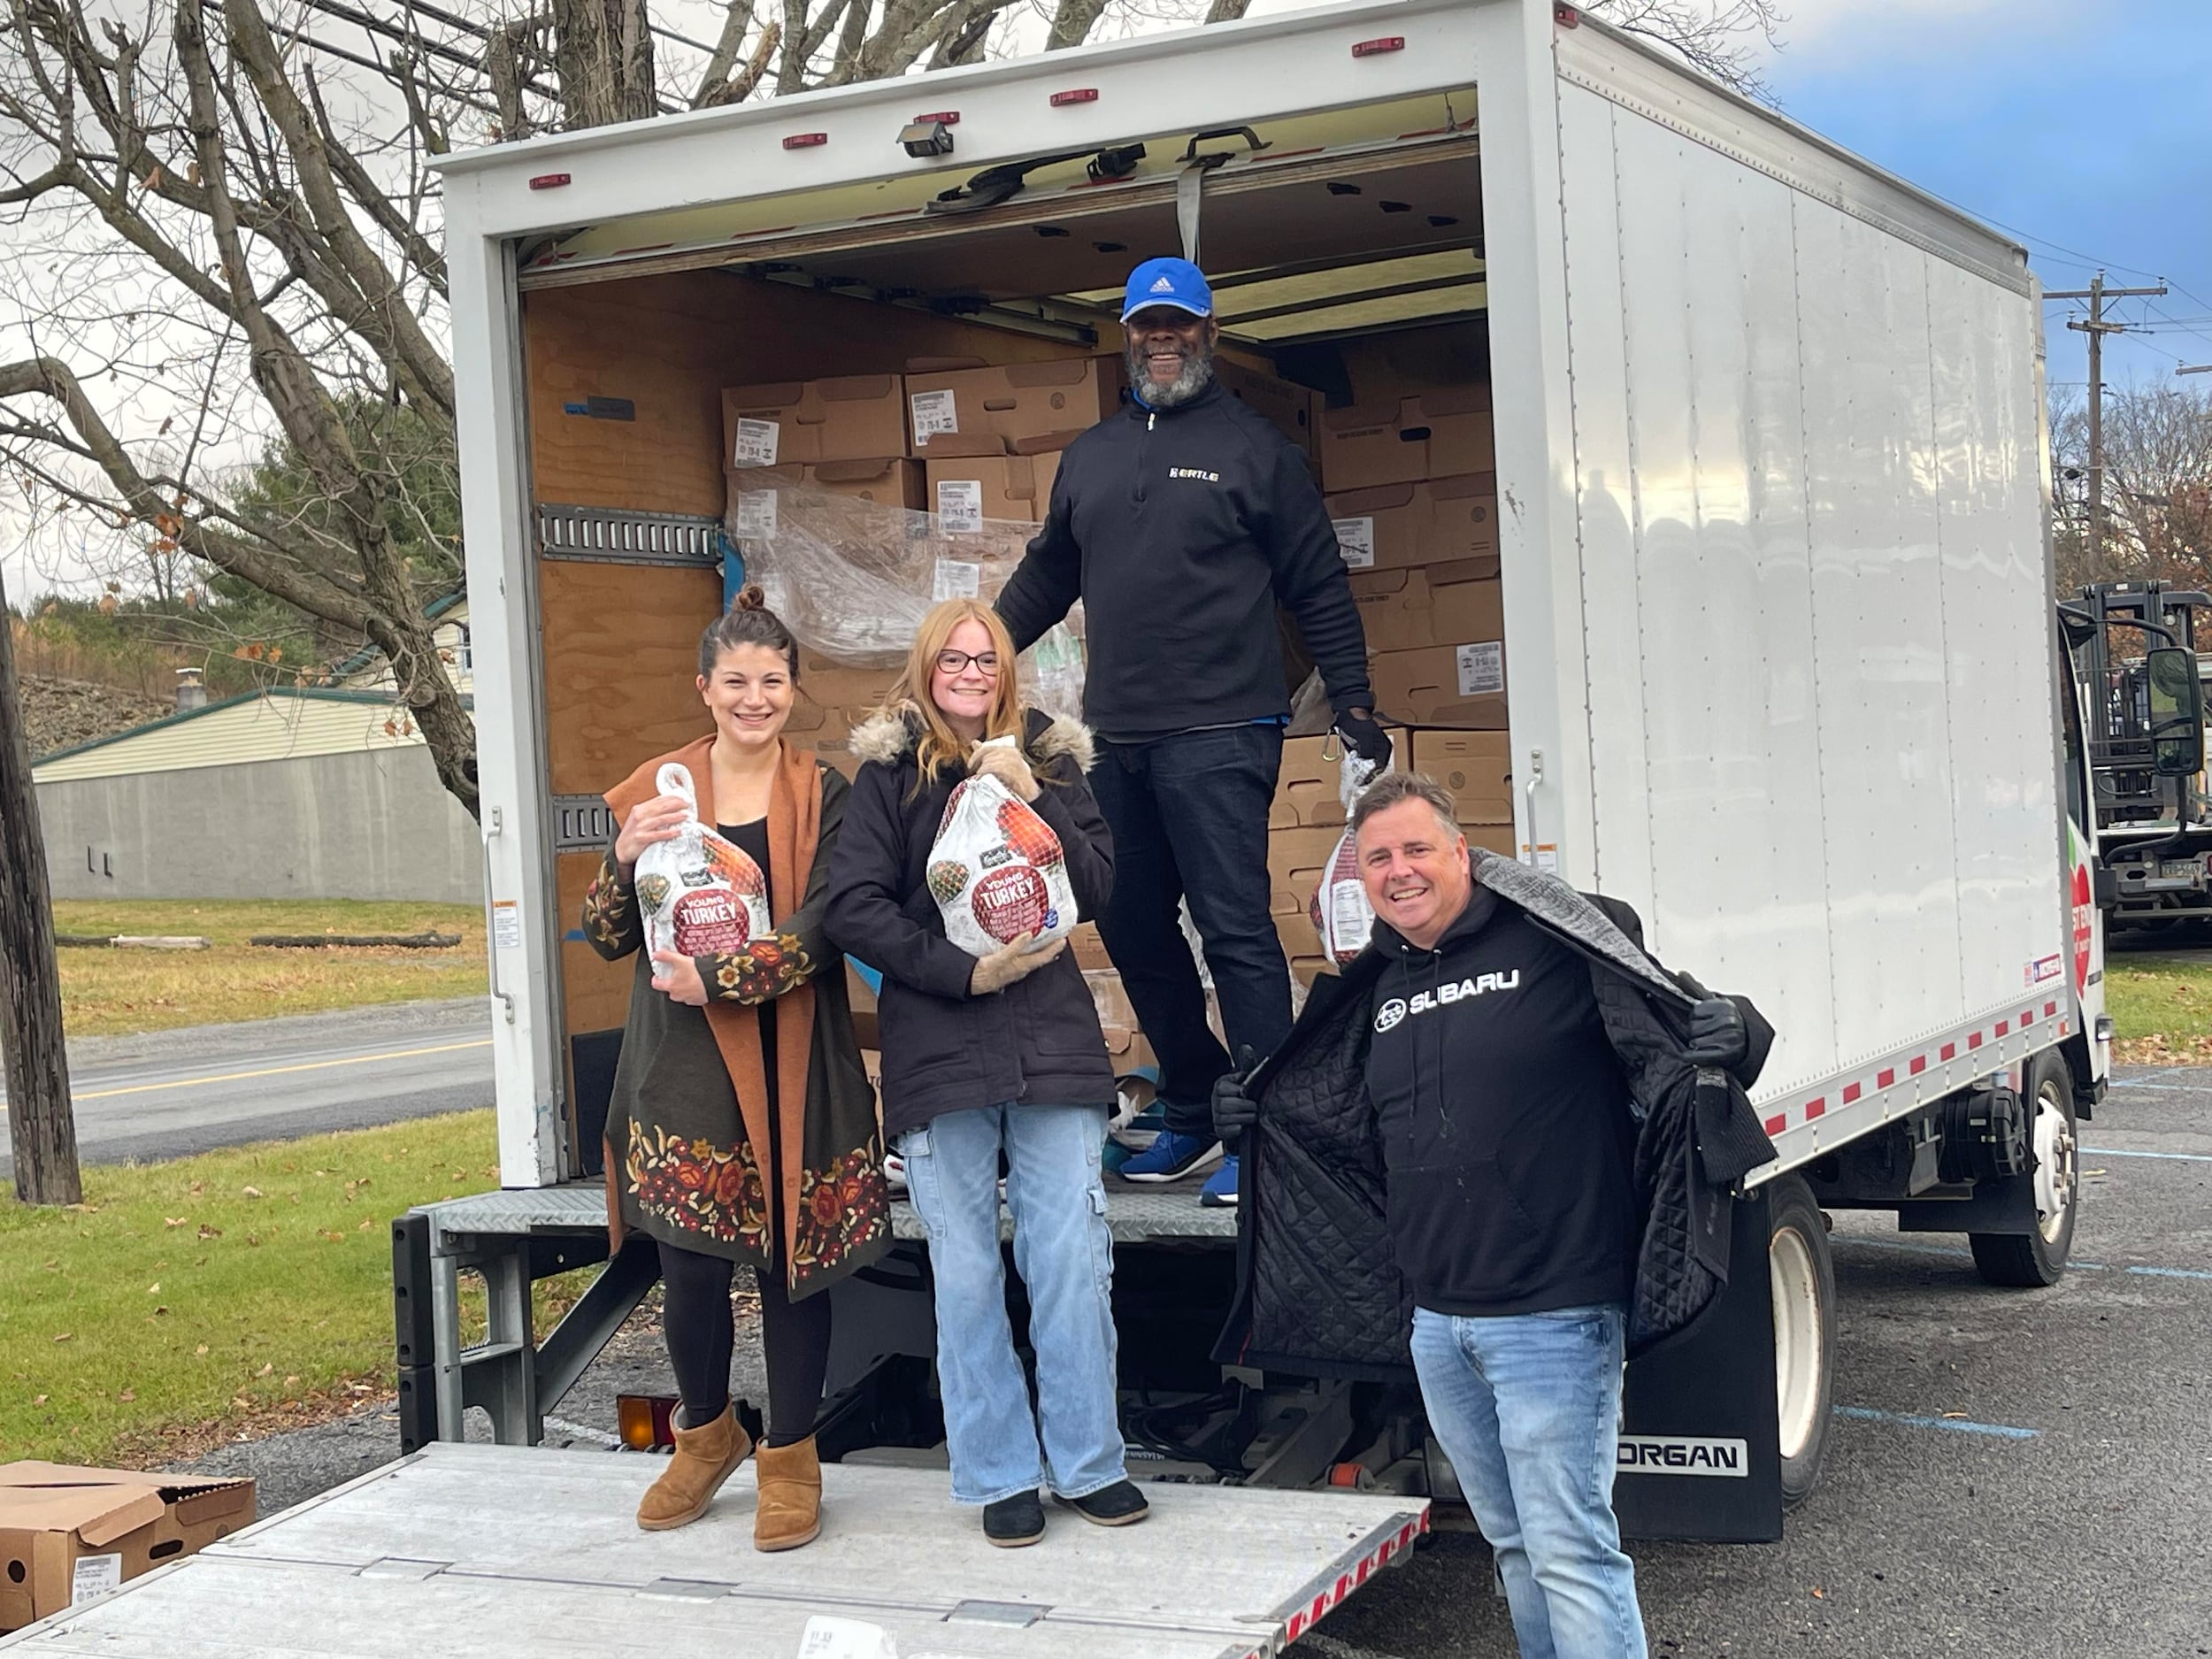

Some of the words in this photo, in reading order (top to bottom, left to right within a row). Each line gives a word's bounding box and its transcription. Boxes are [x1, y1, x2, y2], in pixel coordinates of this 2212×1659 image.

[980, 877, 1034, 910] TURKEY
[985, 872, 1024, 890] YOUNG
[680, 902, 736, 926] TURKEY
[686, 895, 725, 908] YOUNG
[1409, 969, 1519, 1015] SUBARU
[1617, 1442, 1738, 1469] ORGAN
